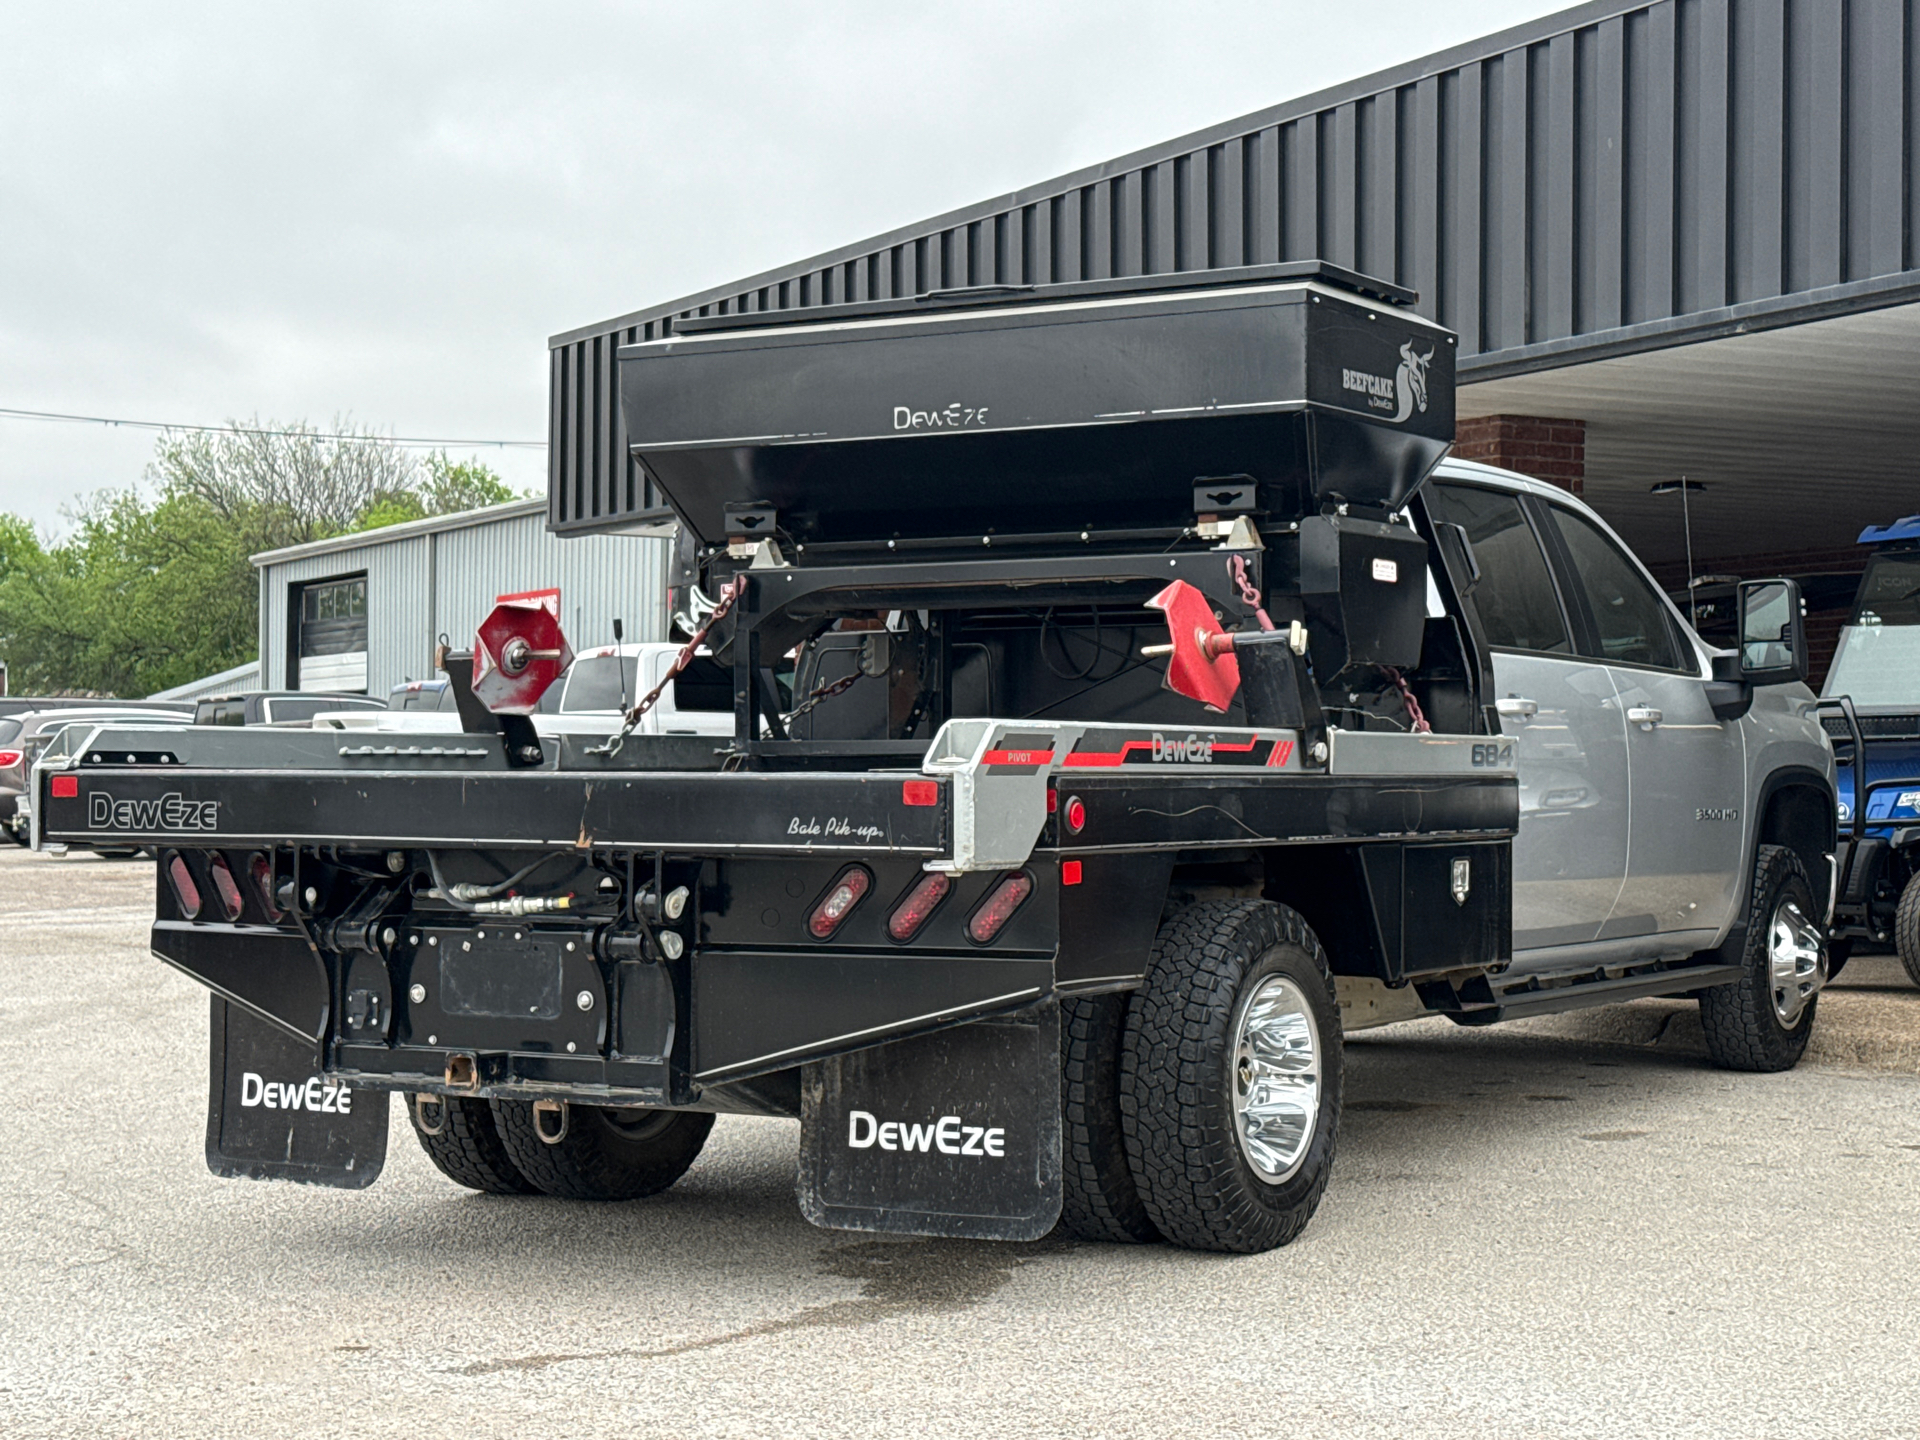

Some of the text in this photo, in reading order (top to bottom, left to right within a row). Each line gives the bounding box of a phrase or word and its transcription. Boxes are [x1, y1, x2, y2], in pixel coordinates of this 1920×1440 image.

[1343, 368, 1394, 399] BEEFCAKE
[1007, 752, 1032, 763] PIVOT
[1152, 733, 1213, 763] DewEze
[1472, 744, 1514, 768] 684
[88, 791, 217, 830] DewEze
[787, 816, 821, 835] Bale
[1696, 809, 1738, 820] 3500 HD
[241, 1072, 352, 1114] DewEze
[849, 1110, 1005, 1157] DewEze
